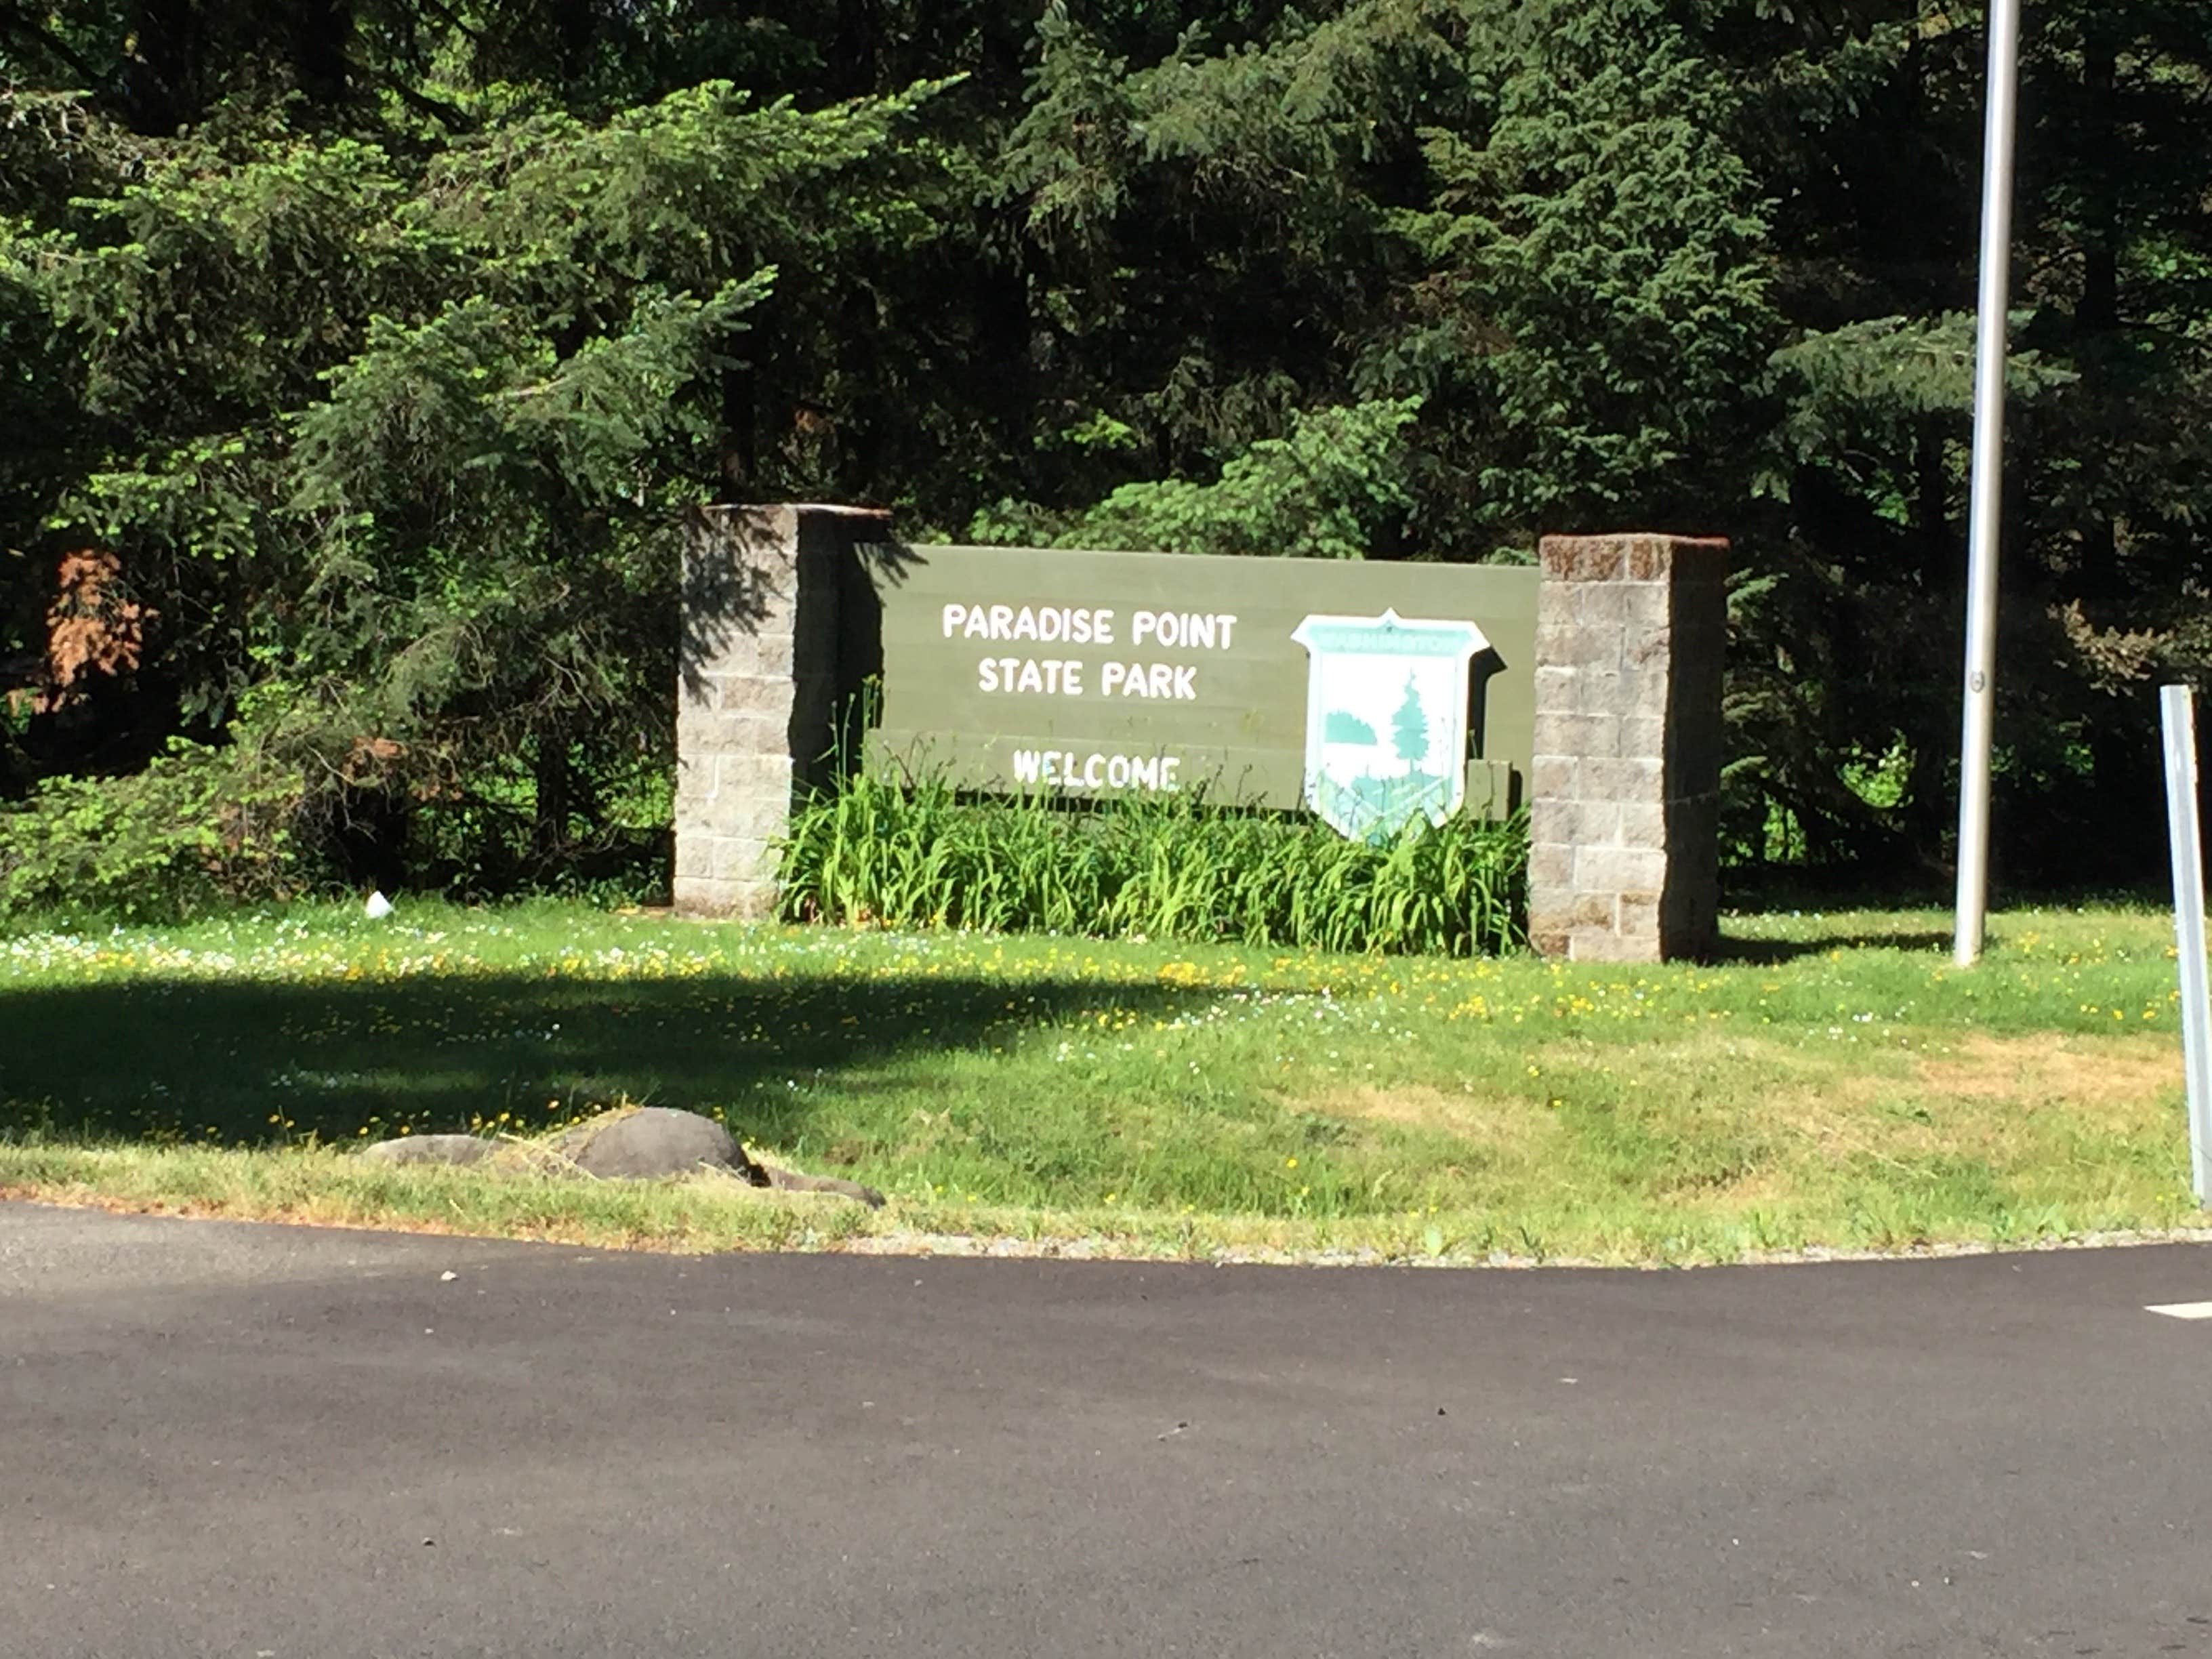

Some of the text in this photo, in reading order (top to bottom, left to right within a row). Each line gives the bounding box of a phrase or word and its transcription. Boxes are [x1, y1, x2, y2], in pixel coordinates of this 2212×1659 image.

[943, 604, 1237, 650] PARADISE POINT
[978, 657, 1197, 700] STATE PARK
[1013, 750, 1181, 792] WELCOME
